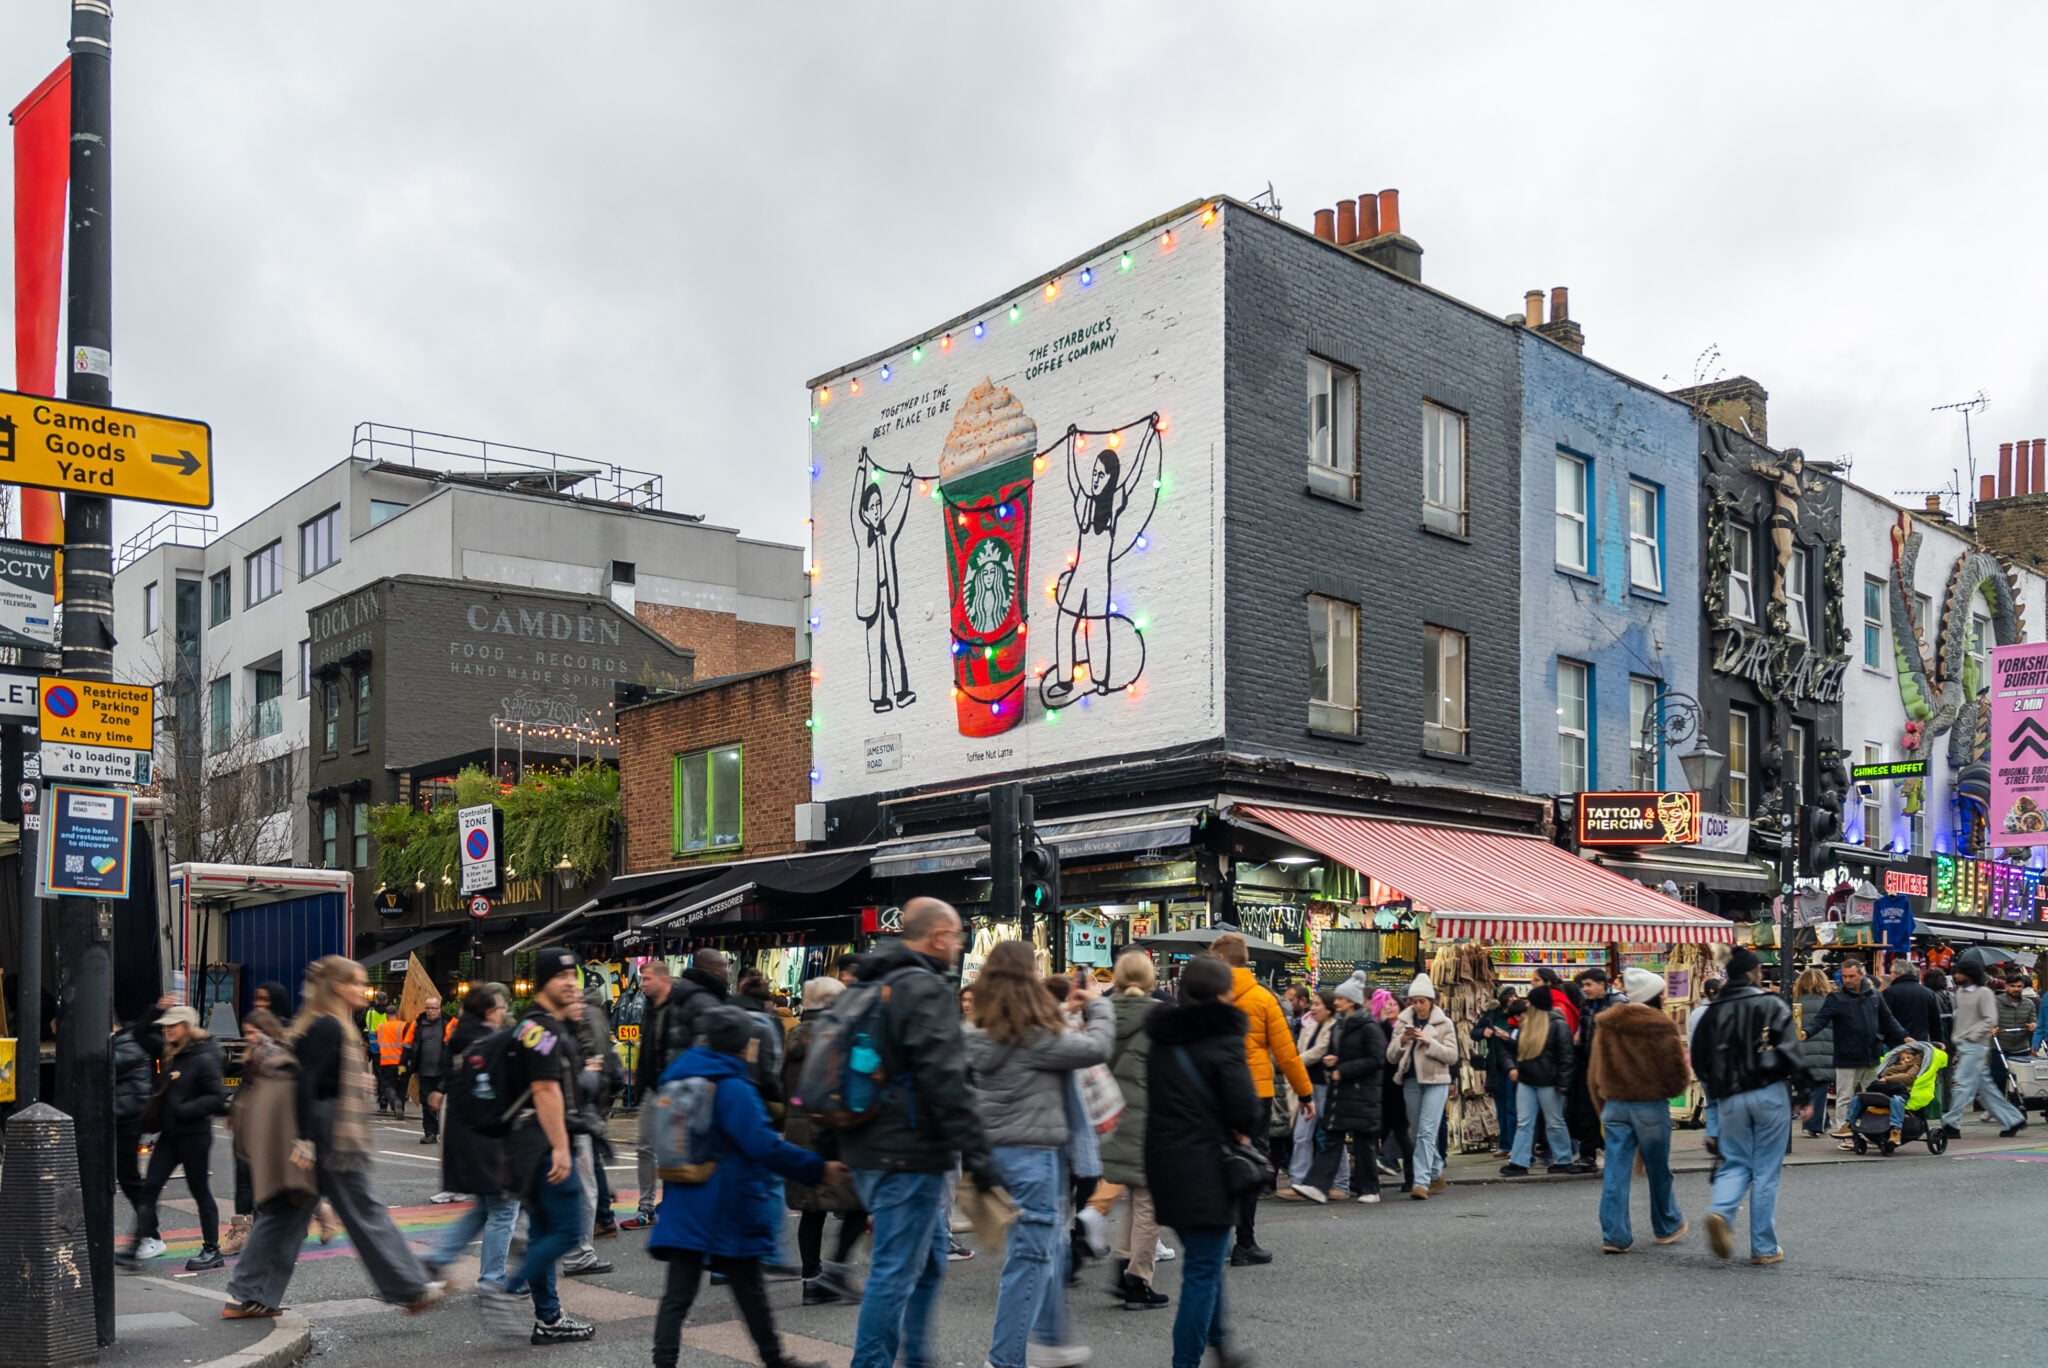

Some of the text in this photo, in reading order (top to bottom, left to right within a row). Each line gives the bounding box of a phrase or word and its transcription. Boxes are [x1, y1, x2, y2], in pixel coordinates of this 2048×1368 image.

[1029, 317, 1111, 362] THE STARBUCKS
[1026, 334, 1116, 380] COFFEE COMPANY
[881, 384, 949, 420] TOGETHER IS THE
[33, 405, 136, 439] Camden
[873, 399, 951, 440] BEST PLACE TO BE
[45, 433, 125, 462] Goods
[57, 460, 114, 486] Yard
[3, 599, 37, 609] TELEVISION
[314, 589, 380, 643] LOCK INN
[466, 604, 620, 646] CAMDEN
[450, 642, 504, 660] FOOD
[535, 651, 628, 673] RECORDS
[1997, 655, 2048, 674] YORKSHI
[451, 662, 628, 690] HAND MADE SPIRIT
[83, 686, 148, 702] Restricted
[92, 700, 139, 715] Parking
[2013, 697, 2044, 712] 2 MIN
[101, 714, 131, 726] Zone
[61, 727, 133, 742] At any time
[86, 751, 131, 765] loading
[966, 748, 1013, 762] Toffee Nut Latte
[867, 759, 882, 768] ROAD
[1854, 762, 1924, 777] CHINESE BUFFET
[79, 766, 101, 776] any
[105, 766, 132, 777] time
[1999, 767, 2029, 777] ORIGINAL
[2005, 776, 2030, 785] STREET
[73, 800, 107, 808] JAMESTOWN
[460, 807, 491, 818] Controlled
[1587, 807, 1655, 819] TATTOO &
[71, 825, 108, 835] More bars
[465, 817, 487, 828] ZONE
[1587, 818, 1654, 830] PIERCING
[1707, 818, 1728, 836] CODE
[76, 834, 118, 843] restaurants
[78, 841, 110, 849] discover
[1884, 869, 1928, 897] CHINESE
[1937, 854, 2041, 919] BUFFET
[498, 879, 542, 905] AMDEN
[474, 902, 487, 911] 20
[688, 910, 704, 923] BAGS
[706, 894, 744, 916] ACCESSORIES
[621, 1027, 637, 1038] £10
